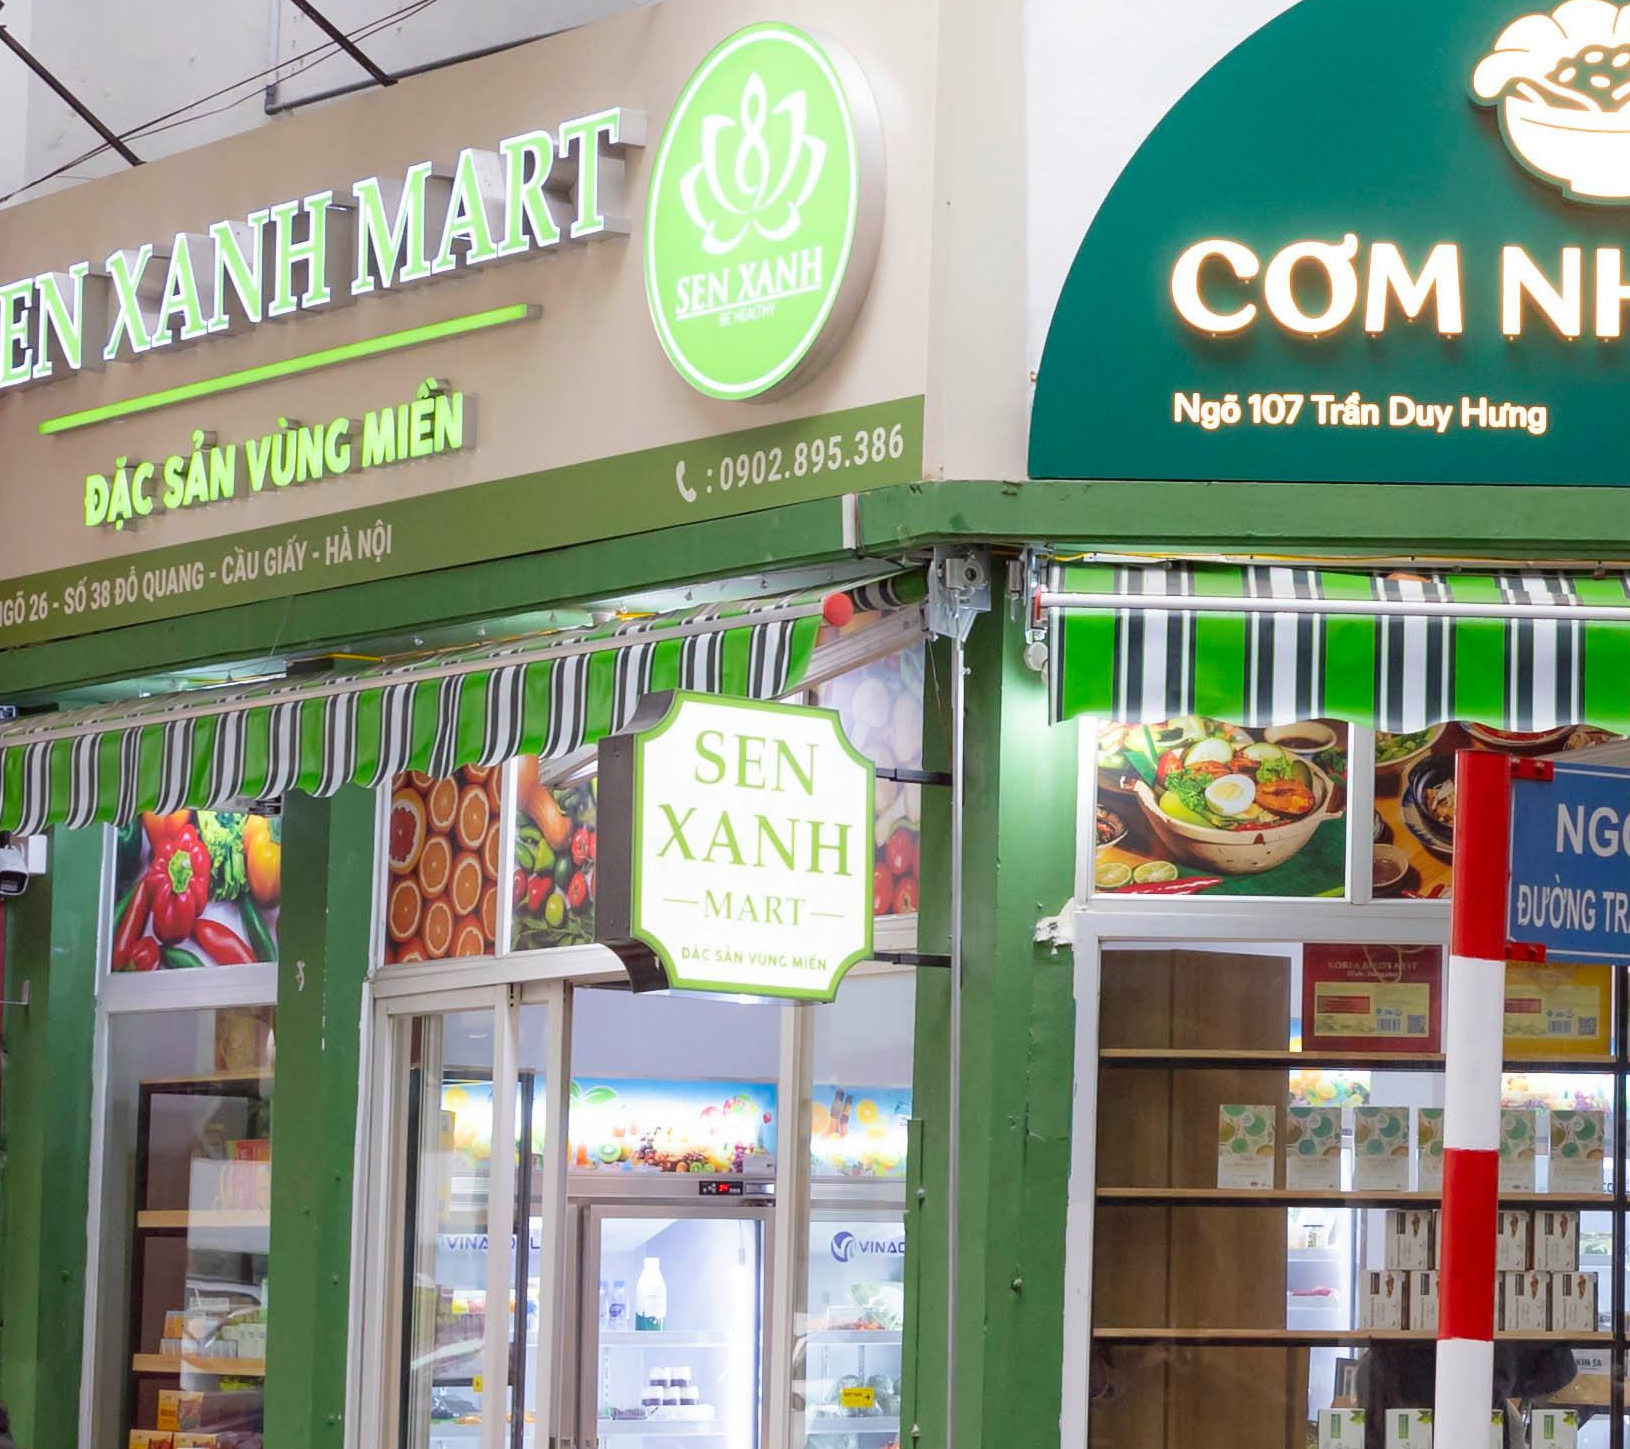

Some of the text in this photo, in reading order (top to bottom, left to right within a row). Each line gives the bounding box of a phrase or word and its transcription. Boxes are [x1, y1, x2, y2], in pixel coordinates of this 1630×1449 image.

[106, 189, 334, 360] XANH
[351, 107, 622, 294] MART
[676, 246, 825, 315] SEN XANH
[1170, 233, 1463, 336] CƠM
[1173, 391, 1548, 435] Ngõ 107 Trần Duy Hưng
[84, 377, 464, 531] ĐẶC SẢN VÙNG MIỀN
[30, 593, 49, 621] 26
[64, 576, 87, 615] SỐ
[90, 581, 111, 609] 38
[114, 566, 138, 606] ĐỖ
[142, 561, 205, 603] QUANG
[221, 546, 260, 585] CẦU
[264, 535, 308, 577] GIẤY
[326, 525, 353, 566] HÀ
[357, 519, 392, 564] NỘI
[694, 729, 819, 796] SEN
[656, 803, 853, 877] XANH
[703, 889, 806, 927] MART
[1517, 874, 1596, 932] ĐƯỜNG
